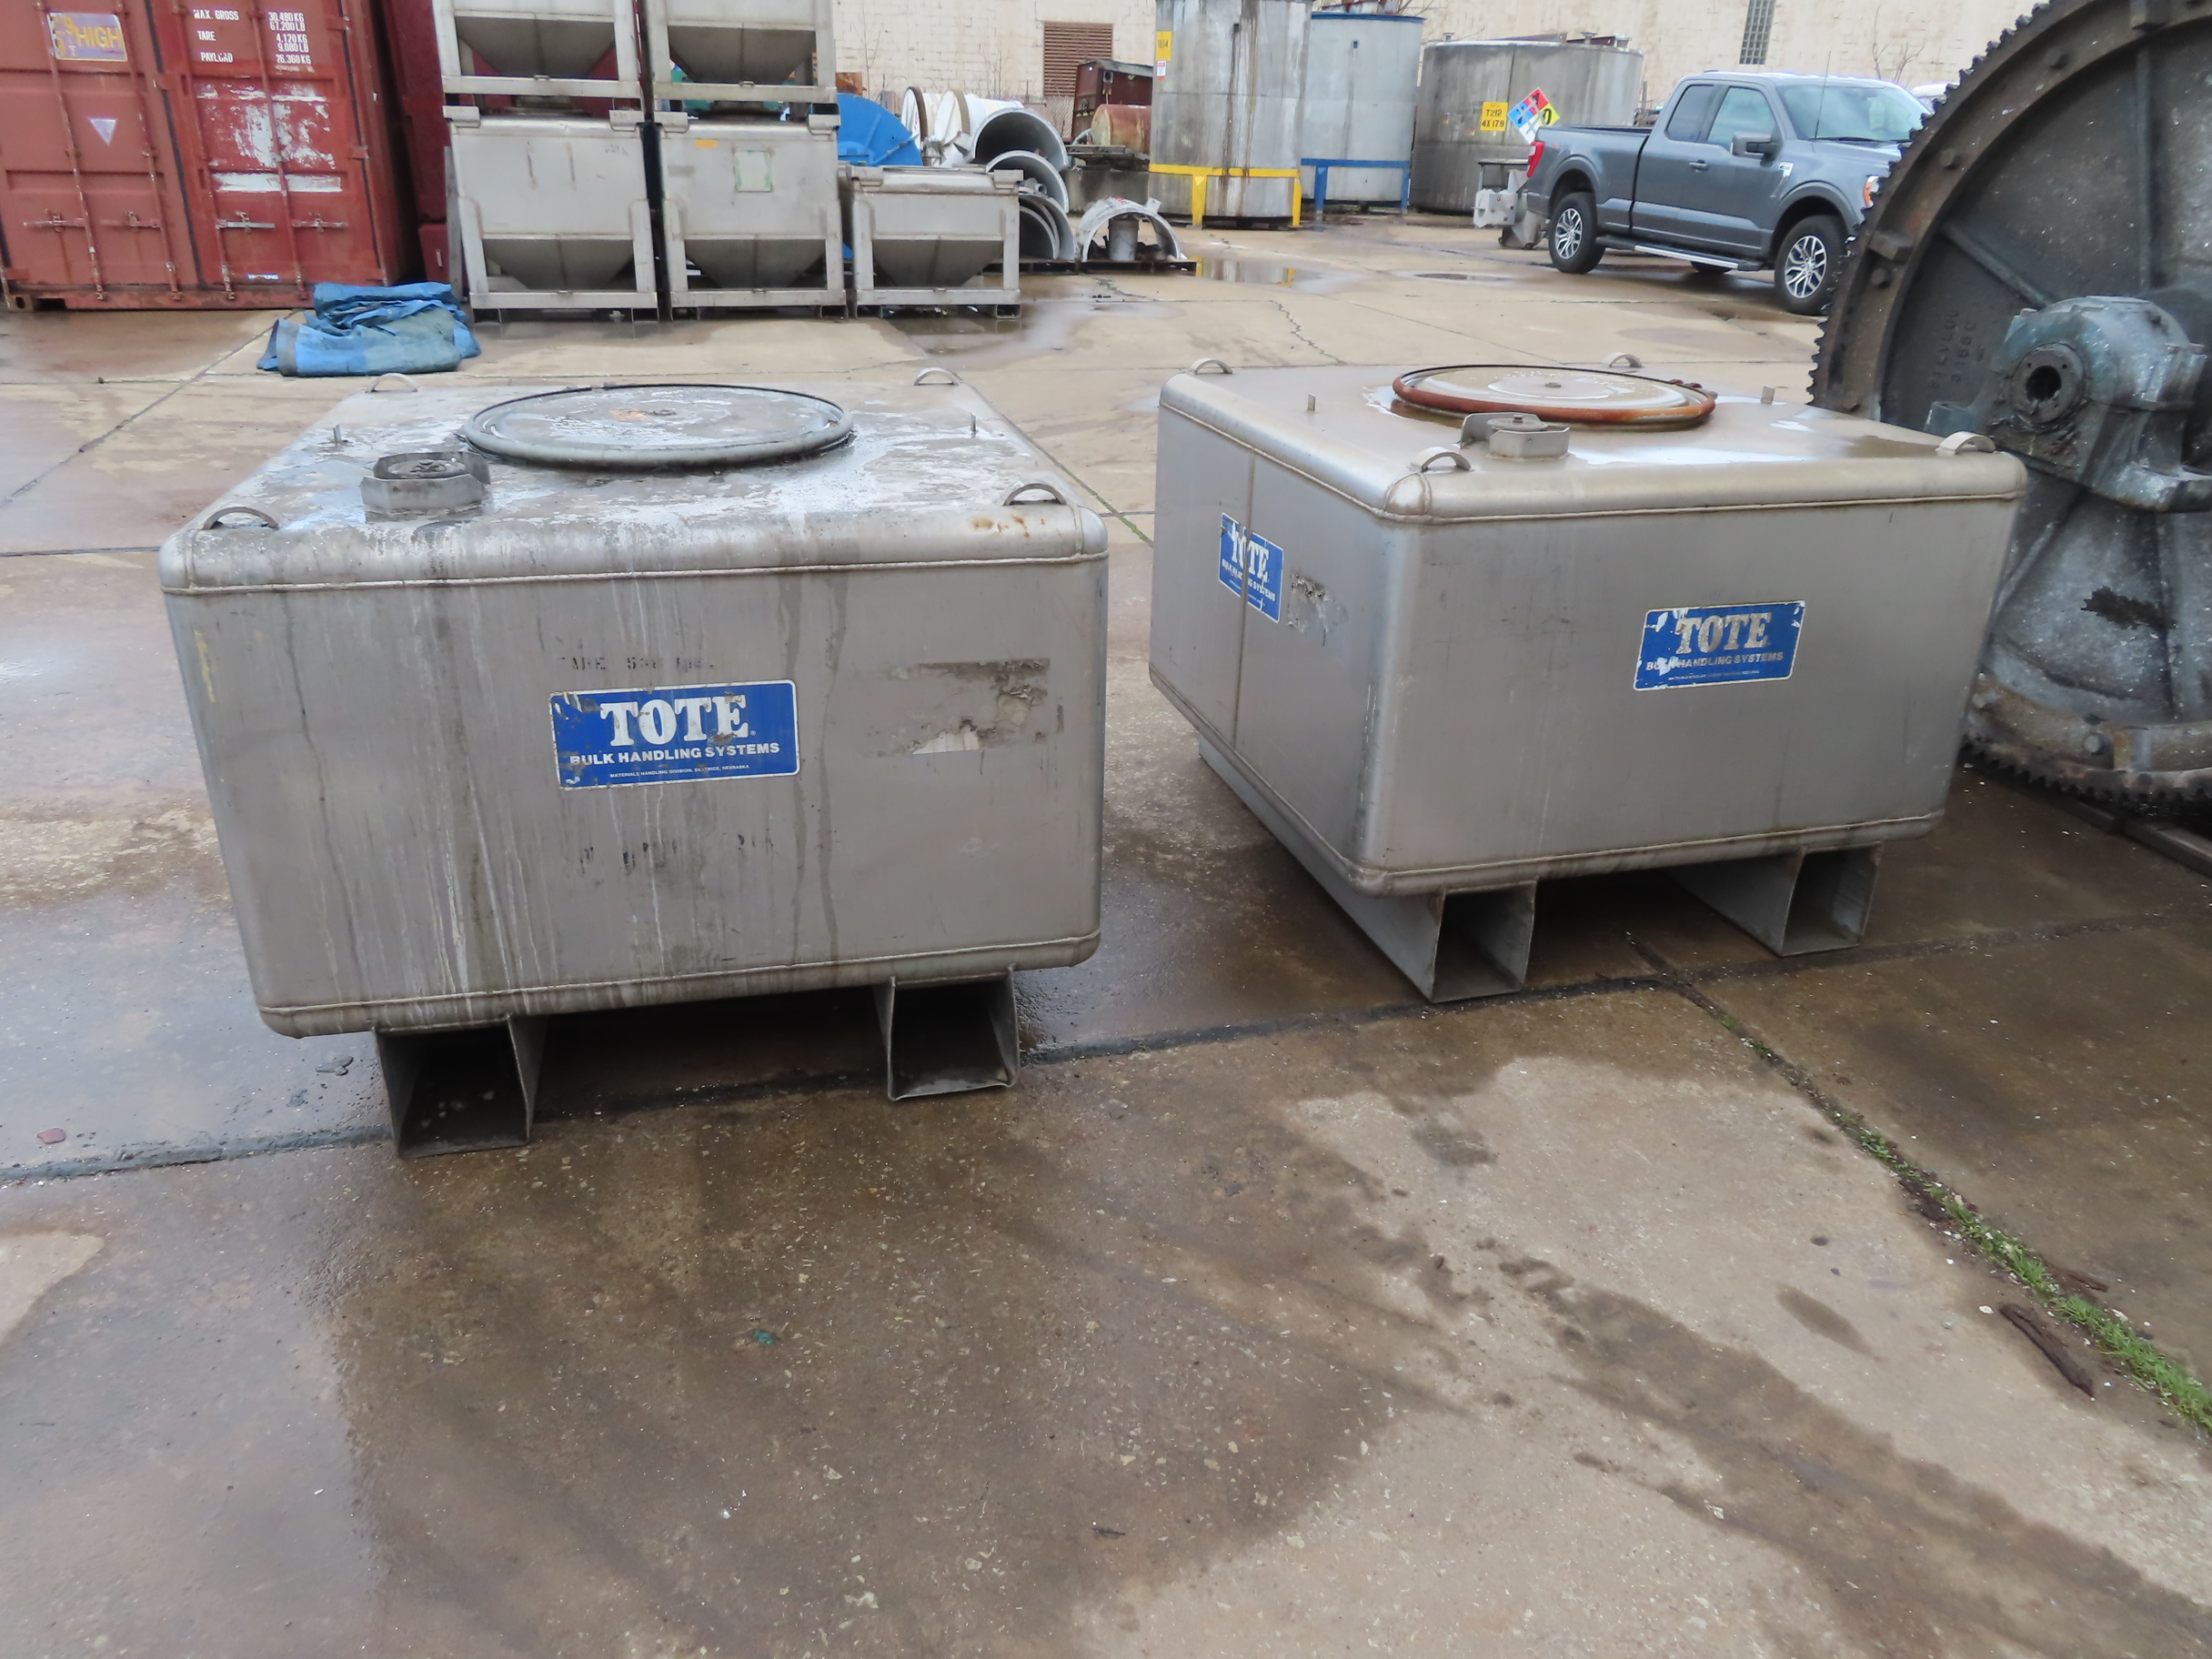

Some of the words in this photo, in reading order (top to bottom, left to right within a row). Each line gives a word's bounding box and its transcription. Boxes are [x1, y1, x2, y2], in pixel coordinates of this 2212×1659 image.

[216, 10, 239, 21] GROSS
[268, 12, 294, 23] 30.480
[295, 13, 305, 23] KG
[270, 22, 296, 32] 67.200
[297, 23, 307, 32] LB
[77, 26, 126, 49] HIGH
[197, 31, 216, 41] TARE
[276, 34, 297, 44] 4.120
[298, 35, 308, 44] KG
[277, 43, 298, 53] 9.080
[299, 44, 309, 53] LB
[276, 54, 300, 64] 26.360
[301, 55, 311, 64] KG
[1675, 612, 1772, 654] TOTE
[1678, 656, 1732, 669] HANDLING
[1734, 652, 1784, 664] SYSTEMS
[600, 695, 749, 746] TOTE
[570, 752, 615, 766] BULK
[618, 746, 702, 763] HANDLING
[705, 742, 780, 758] SYSTEMS
[609, 770, 640, 779] MATERIALS
